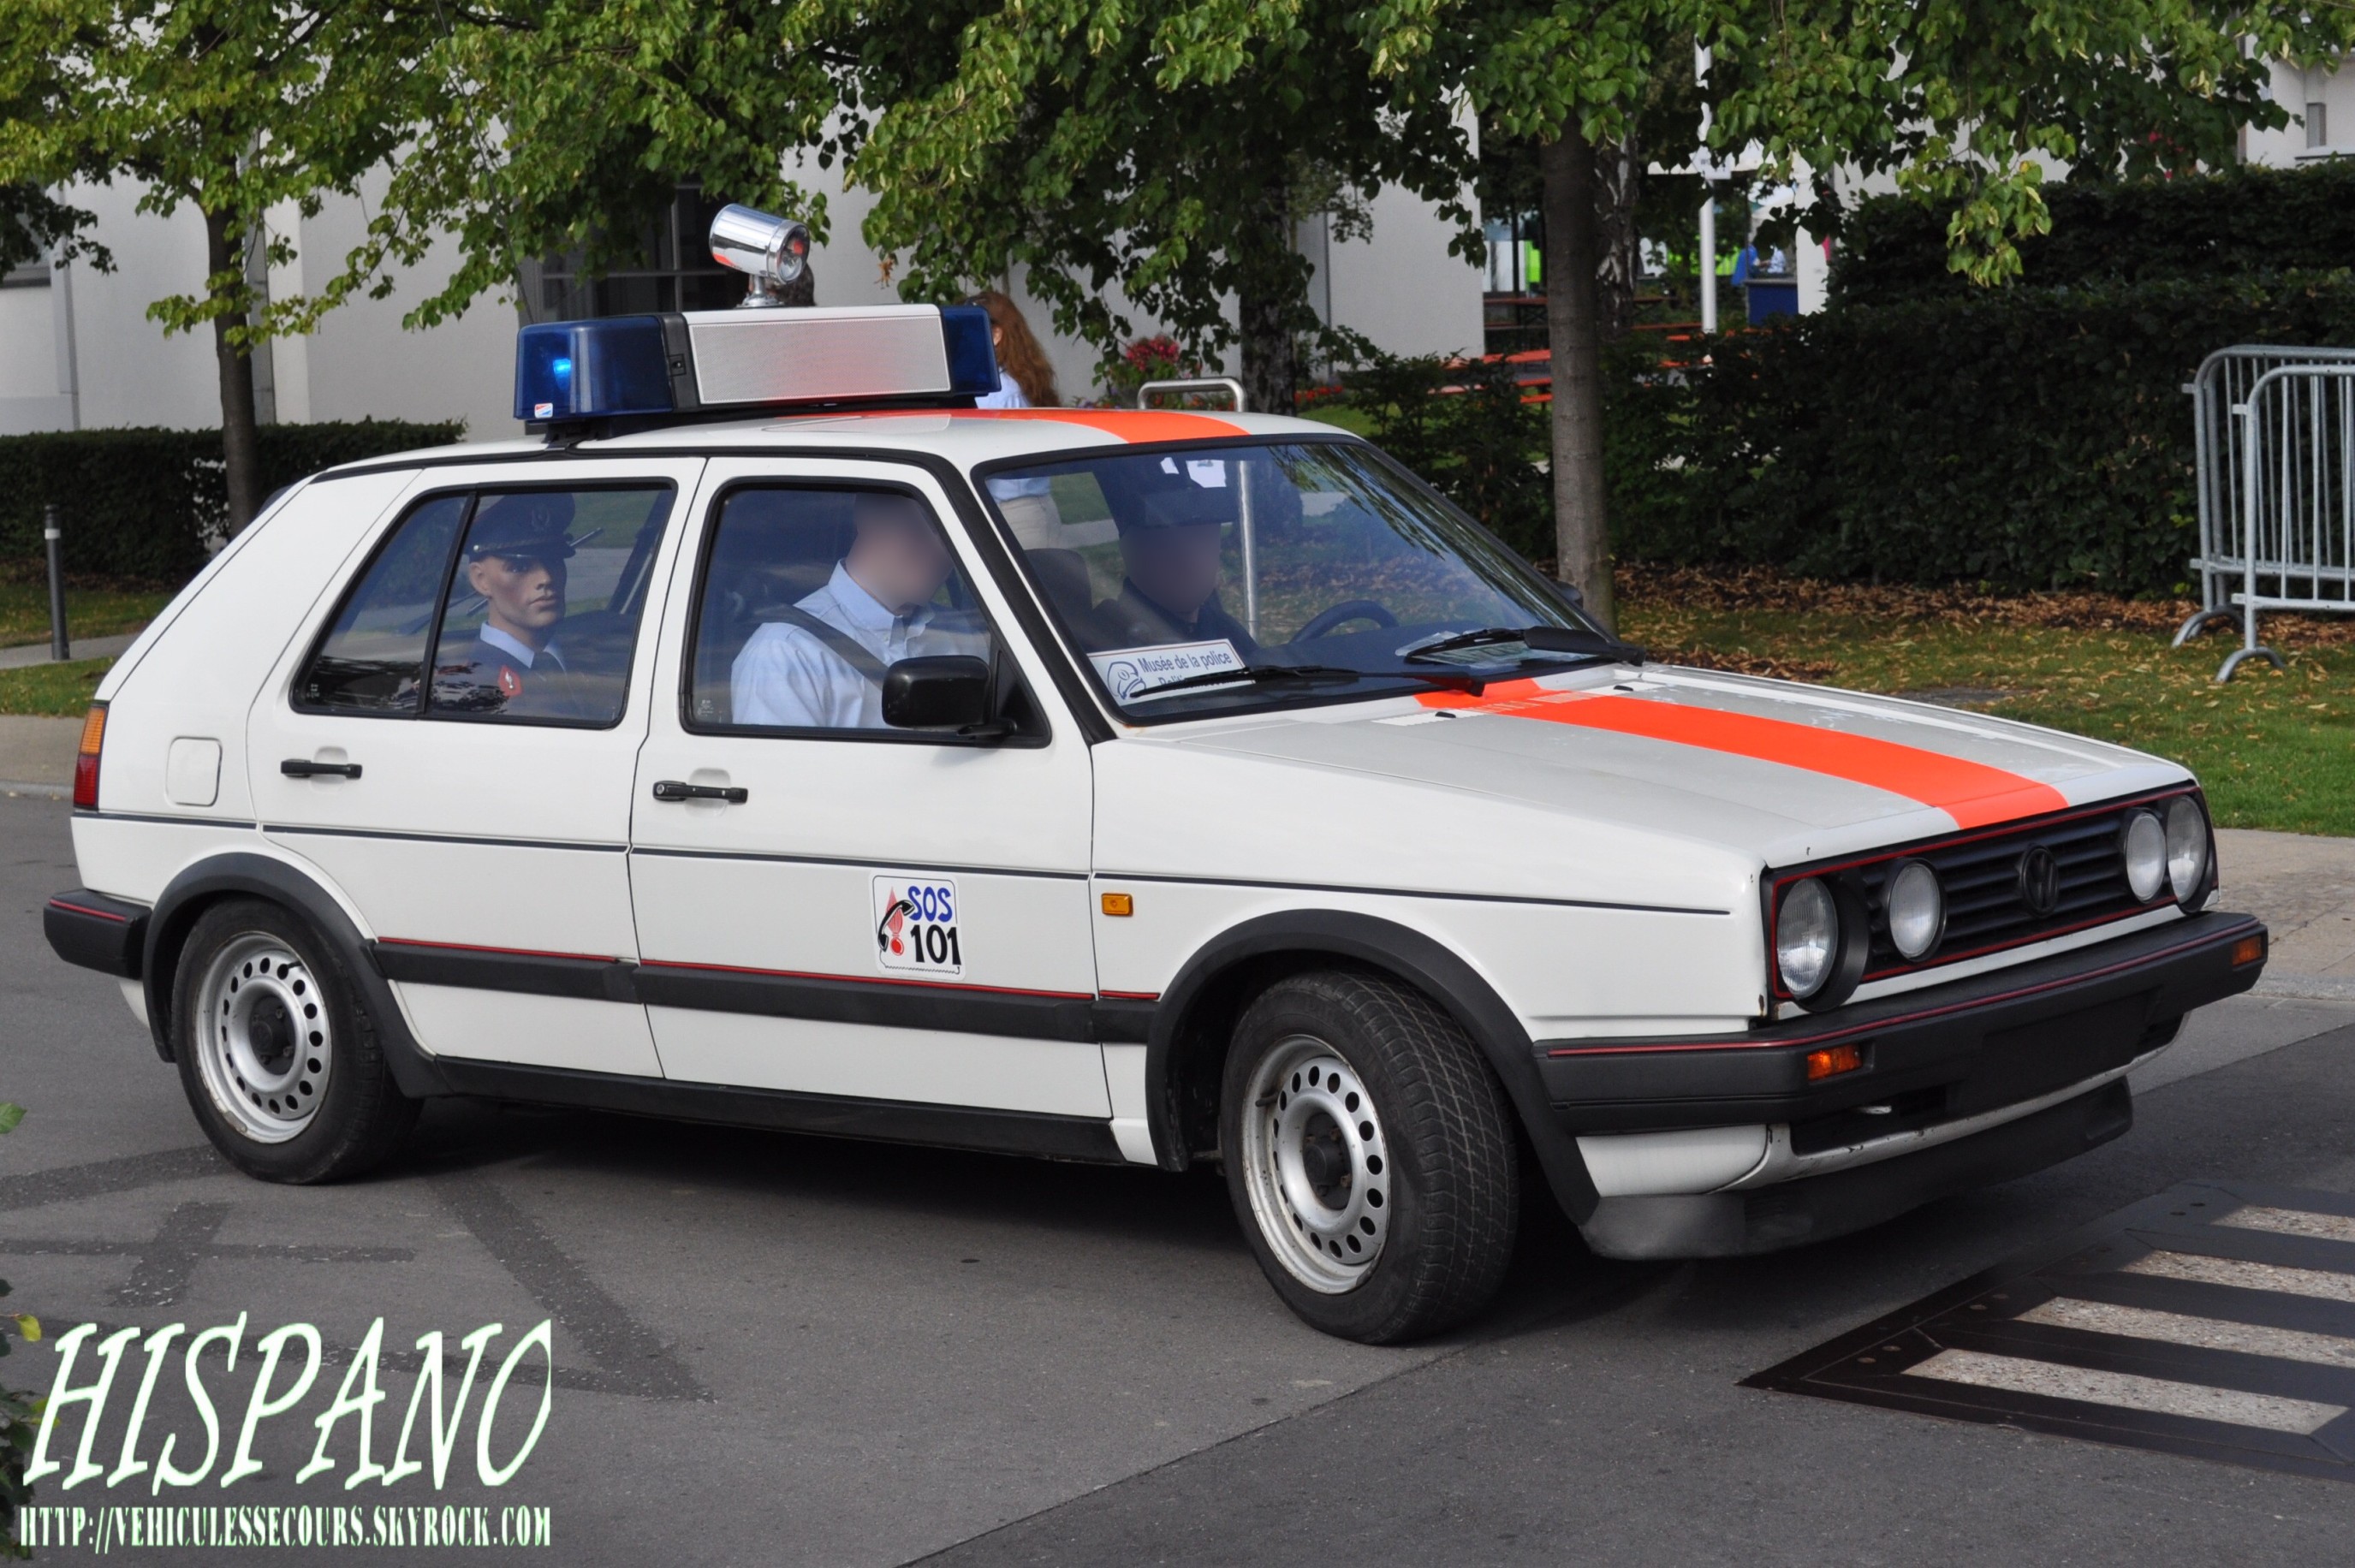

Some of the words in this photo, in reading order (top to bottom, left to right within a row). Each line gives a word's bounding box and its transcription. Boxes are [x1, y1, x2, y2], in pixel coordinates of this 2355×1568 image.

[1138, 656, 1174, 672] Musée
[1175, 654, 1189, 668] de
[1186, 653, 1199, 668] la
[1200, 651, 1232, 669] police
[908, 886, 953, 923] SOS
[911, 924, 961, 965] 101
